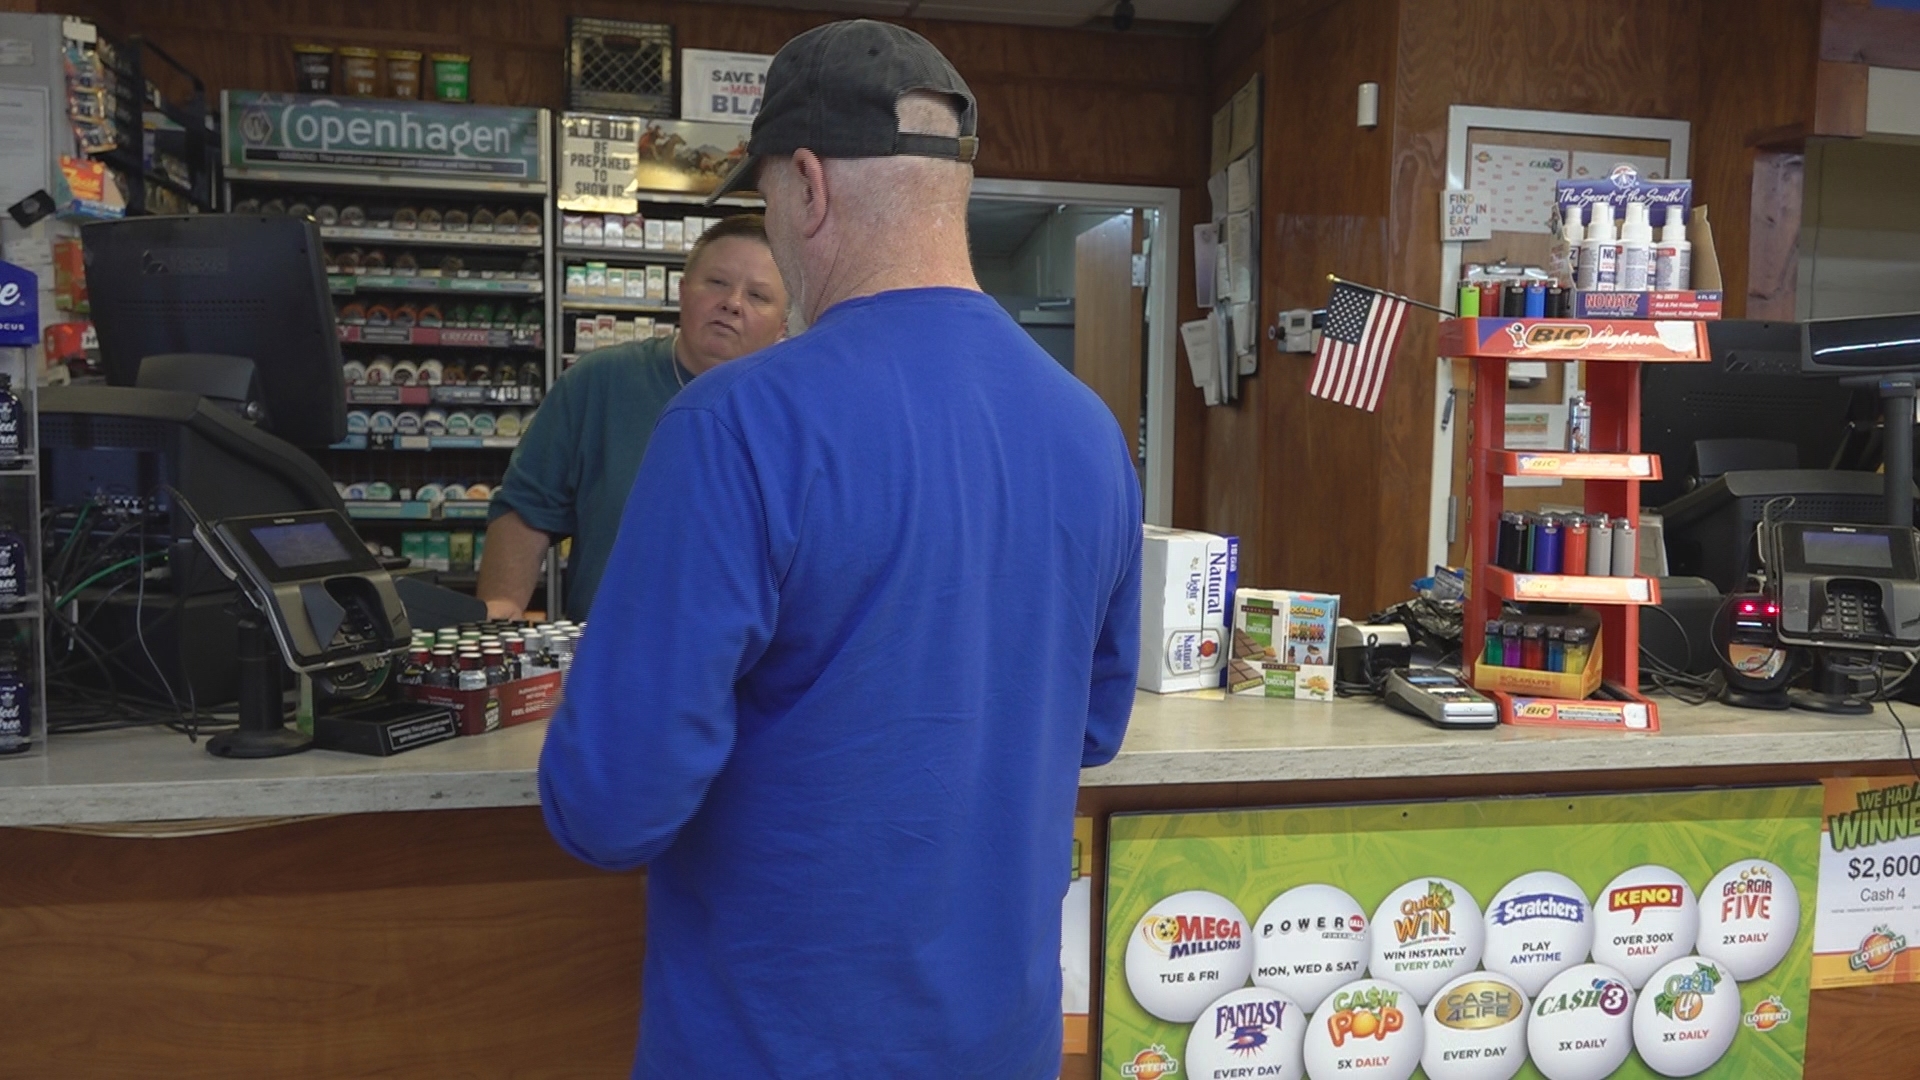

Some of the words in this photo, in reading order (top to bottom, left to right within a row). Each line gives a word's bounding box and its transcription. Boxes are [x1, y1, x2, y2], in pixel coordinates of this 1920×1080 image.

[712, 70, 754, 84] SAVE
[730, 84, 762, 96] MARL
[712, 95, 761, 115] BLA
[281, 99, 510, 158] Copenhagen
[575, 119, 601, 138] WE
[610, 121, 628, 139] ID
[594, 141, 608, 154] BE
[570, 153, 631, 171] PREPARED
[594, 168, 608, 182] TO
[575, 181, 609, 196] SHOW
[612, 184, 625, 197] ID
[1449, 194, 1475, 204] FIND
[1559, 188, 1580, 202] The
[1578, 188, 1615, 208] Secret
[1615, 188, 1628, 205] of
[1627, 188, 1646, 202] the
[1644, 188, 1689, 206] South!
[1449, 204, 1470, 215] JOY
[1476, 203, 1487, 214] IN
[1449, 215, 1478, 225] EACH
[1450, 226, 1471, 237] DAY
[1531, 328, 1586, 344] BIC
[1532, 459, 1557, 467] BIC
[1186, 573, 1201, 599] Light
[1207, 552, 1226, 614] Natural
[1183, 634, 1195, 670] Natural
[1525, 706, 1551, 715] BIC
[1857, 791, 1885, 809] WE
[1888, 786, 1912, 804] HAD
[1829, 799, 1920, 852] WINNE
[1848, 854, 1920, 881] $2,600
[1723, 878, 1772, 898] GEORGIA
[1860, 886, 1894, 902] Cash
[1898, 887, 1906, 899] 4
[1400, 894, 1442, 915] Quick
[1613, 887, 1678, 907] KENO!
[1503, 897, 1579, 921] Scratchers
[1721, 895, 1772, 923] FIVE
[1175, 915, 1241, 944] MEGA
[1394, 909, 1451, 943] WIN
[1522, 941, 1551, 952] PLAY
[1613, 935, 1643, 946] OVER
[1646, 933, 1674, 944] 300X
[1722, 935, 1736, 945] 2X
[1738, 933, 1769, 943] DAILY
[1168, 940, 1241, 960] MILLIONS
[1384, 950, 1406, 960] WIN
[1409, 947, 1467, 959] INSTANTLY
[1510, 952, 1562, 964] ANYTIME
[1627, 946, 1658, 956] DAILY
[1854, 937, 1905, 964] LOTTERY
[1258, 966, 1290, 977] MON,
[1293, 964, 1322, 975] WED
[1325, 963, 1333, 972] &
[1336, 961, 1359, 972] SAT
[1395, 961, 1430, 972] EVERY
[1433, 959, 1455, 969] DAY
[1160, 972, 1184, 984] TUE
[1187, 972, 1196, 982] &
[1199, 970, 1219, 981] FRI
[1663, 970, 1716, 998] Cash
[1447, 990, 1512, 1006] CASH
[1604, 989, 1624, 1010] 3
[1446, 1005, 1510, 1022] 4LIFE
[1677, 995, 1694, 1019] 4
[1214, 1000, 1287, 1040] FANTASY
[1747, 1011, 1789, 1024] LOTTERY
[1326, 1008, 1404, 1048] POP
[1663, 1032, 1676, 1042] 3X
[1679, 1030, 1710, 1041] DAILY
[1226, 1025, 1268, 1050] 5
[1558, 1041, 1573, 1051] 3X
[1575, 1038, 1607, 1050] DAILY
[1443, 1049, 1483, 1061] EVERY
[1484, 1047, 1507, 1058] DAY
[1124, 1061, 1176, 1074] LOTTERY
[1337, 1059, 1352, 1069] 5X
[1356, 1056, 1390, 1068] DAILY
[1213, 1067, 1254, 1080] EVERY
[1257, 1064, 1283, 1076] DAY
